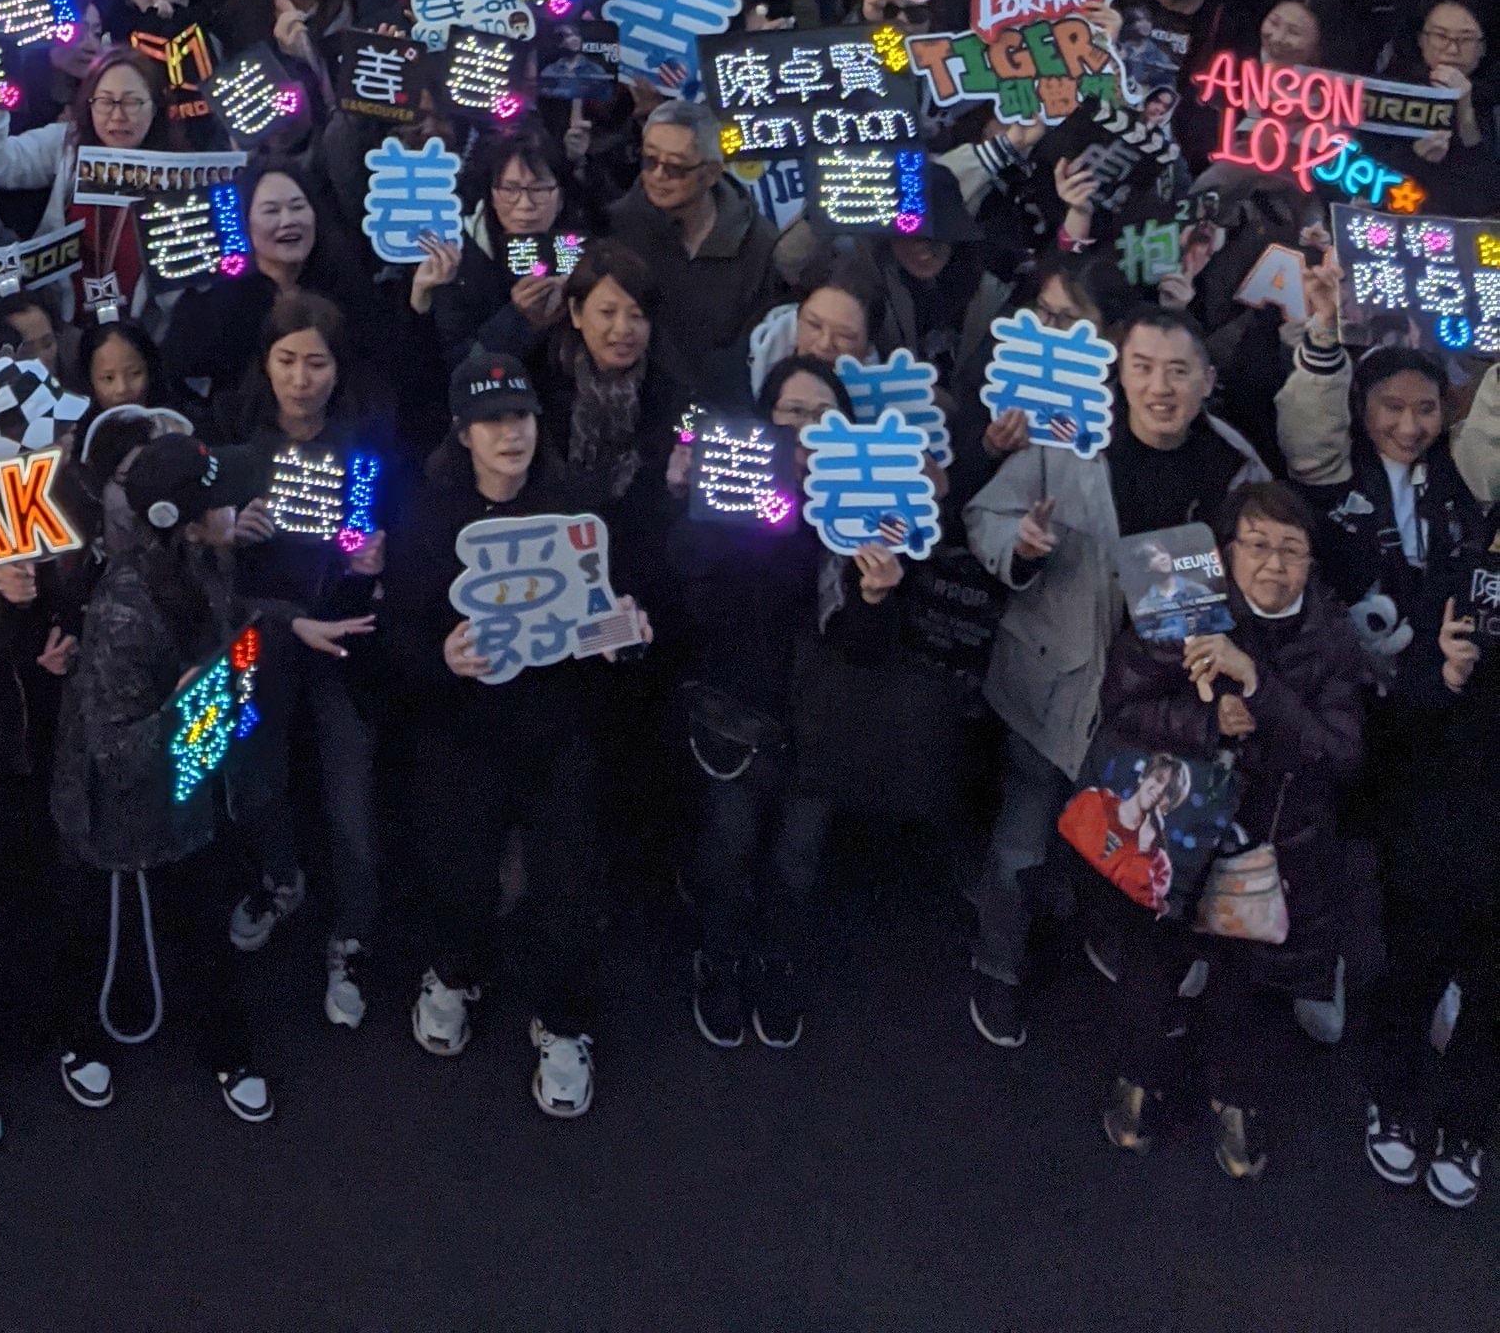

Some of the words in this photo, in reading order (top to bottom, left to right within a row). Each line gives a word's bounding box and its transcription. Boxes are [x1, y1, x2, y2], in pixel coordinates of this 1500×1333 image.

[714, 41, 888, 109] 陳卓賢
[911, 19, 1108, 100] TIGER
[1193, 50, 1365, 127] ANSON
[738, 113, 806, 152] Ian
[811, 107, 919, 147] Chan
[1207, 106, 1290, 173] LO
[1314, 139, 1406, 205] Jer
[1173, 551, 1219, 571] KEUNG
[1202, 564, 1224, 579] TO
